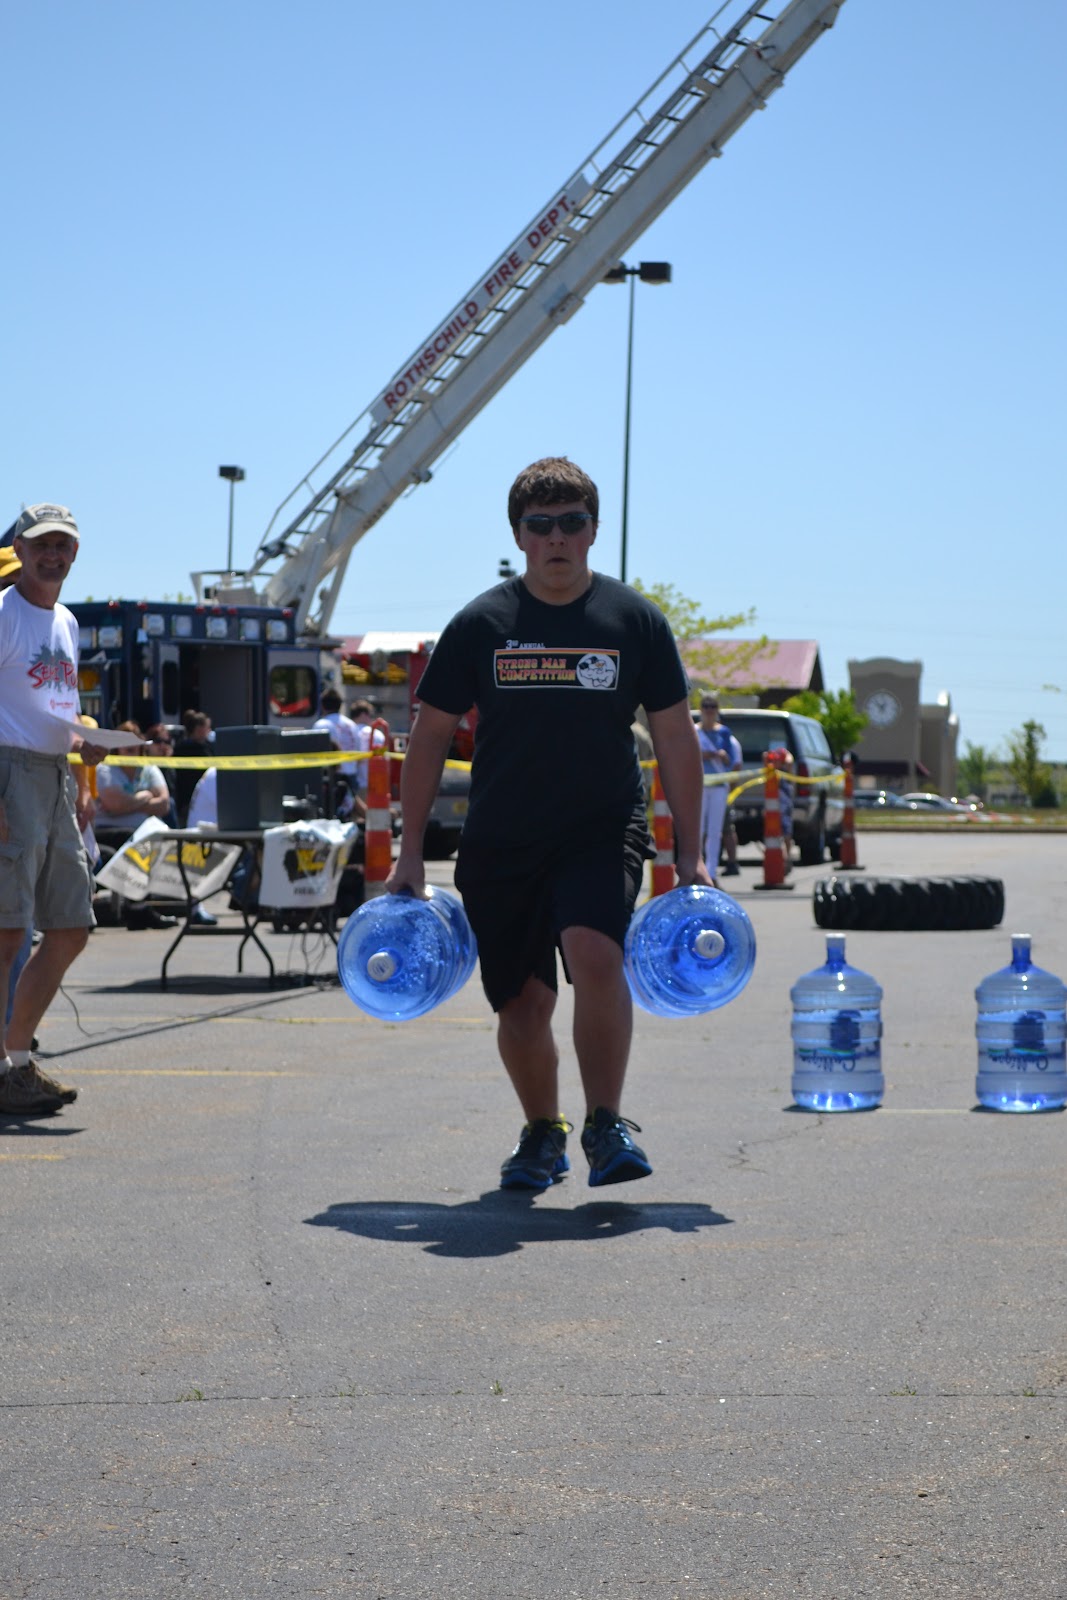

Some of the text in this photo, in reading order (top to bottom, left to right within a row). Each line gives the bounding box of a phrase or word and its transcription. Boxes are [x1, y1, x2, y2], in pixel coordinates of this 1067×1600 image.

[383, 195, 576, 409] ROTHSCHILD FIRE DEPT.
[519, 642, 546, 650] ANNUAL
[497, 657, 567, 670] STRONG MAN
[499, 669, 577, 681] COMPETITION
